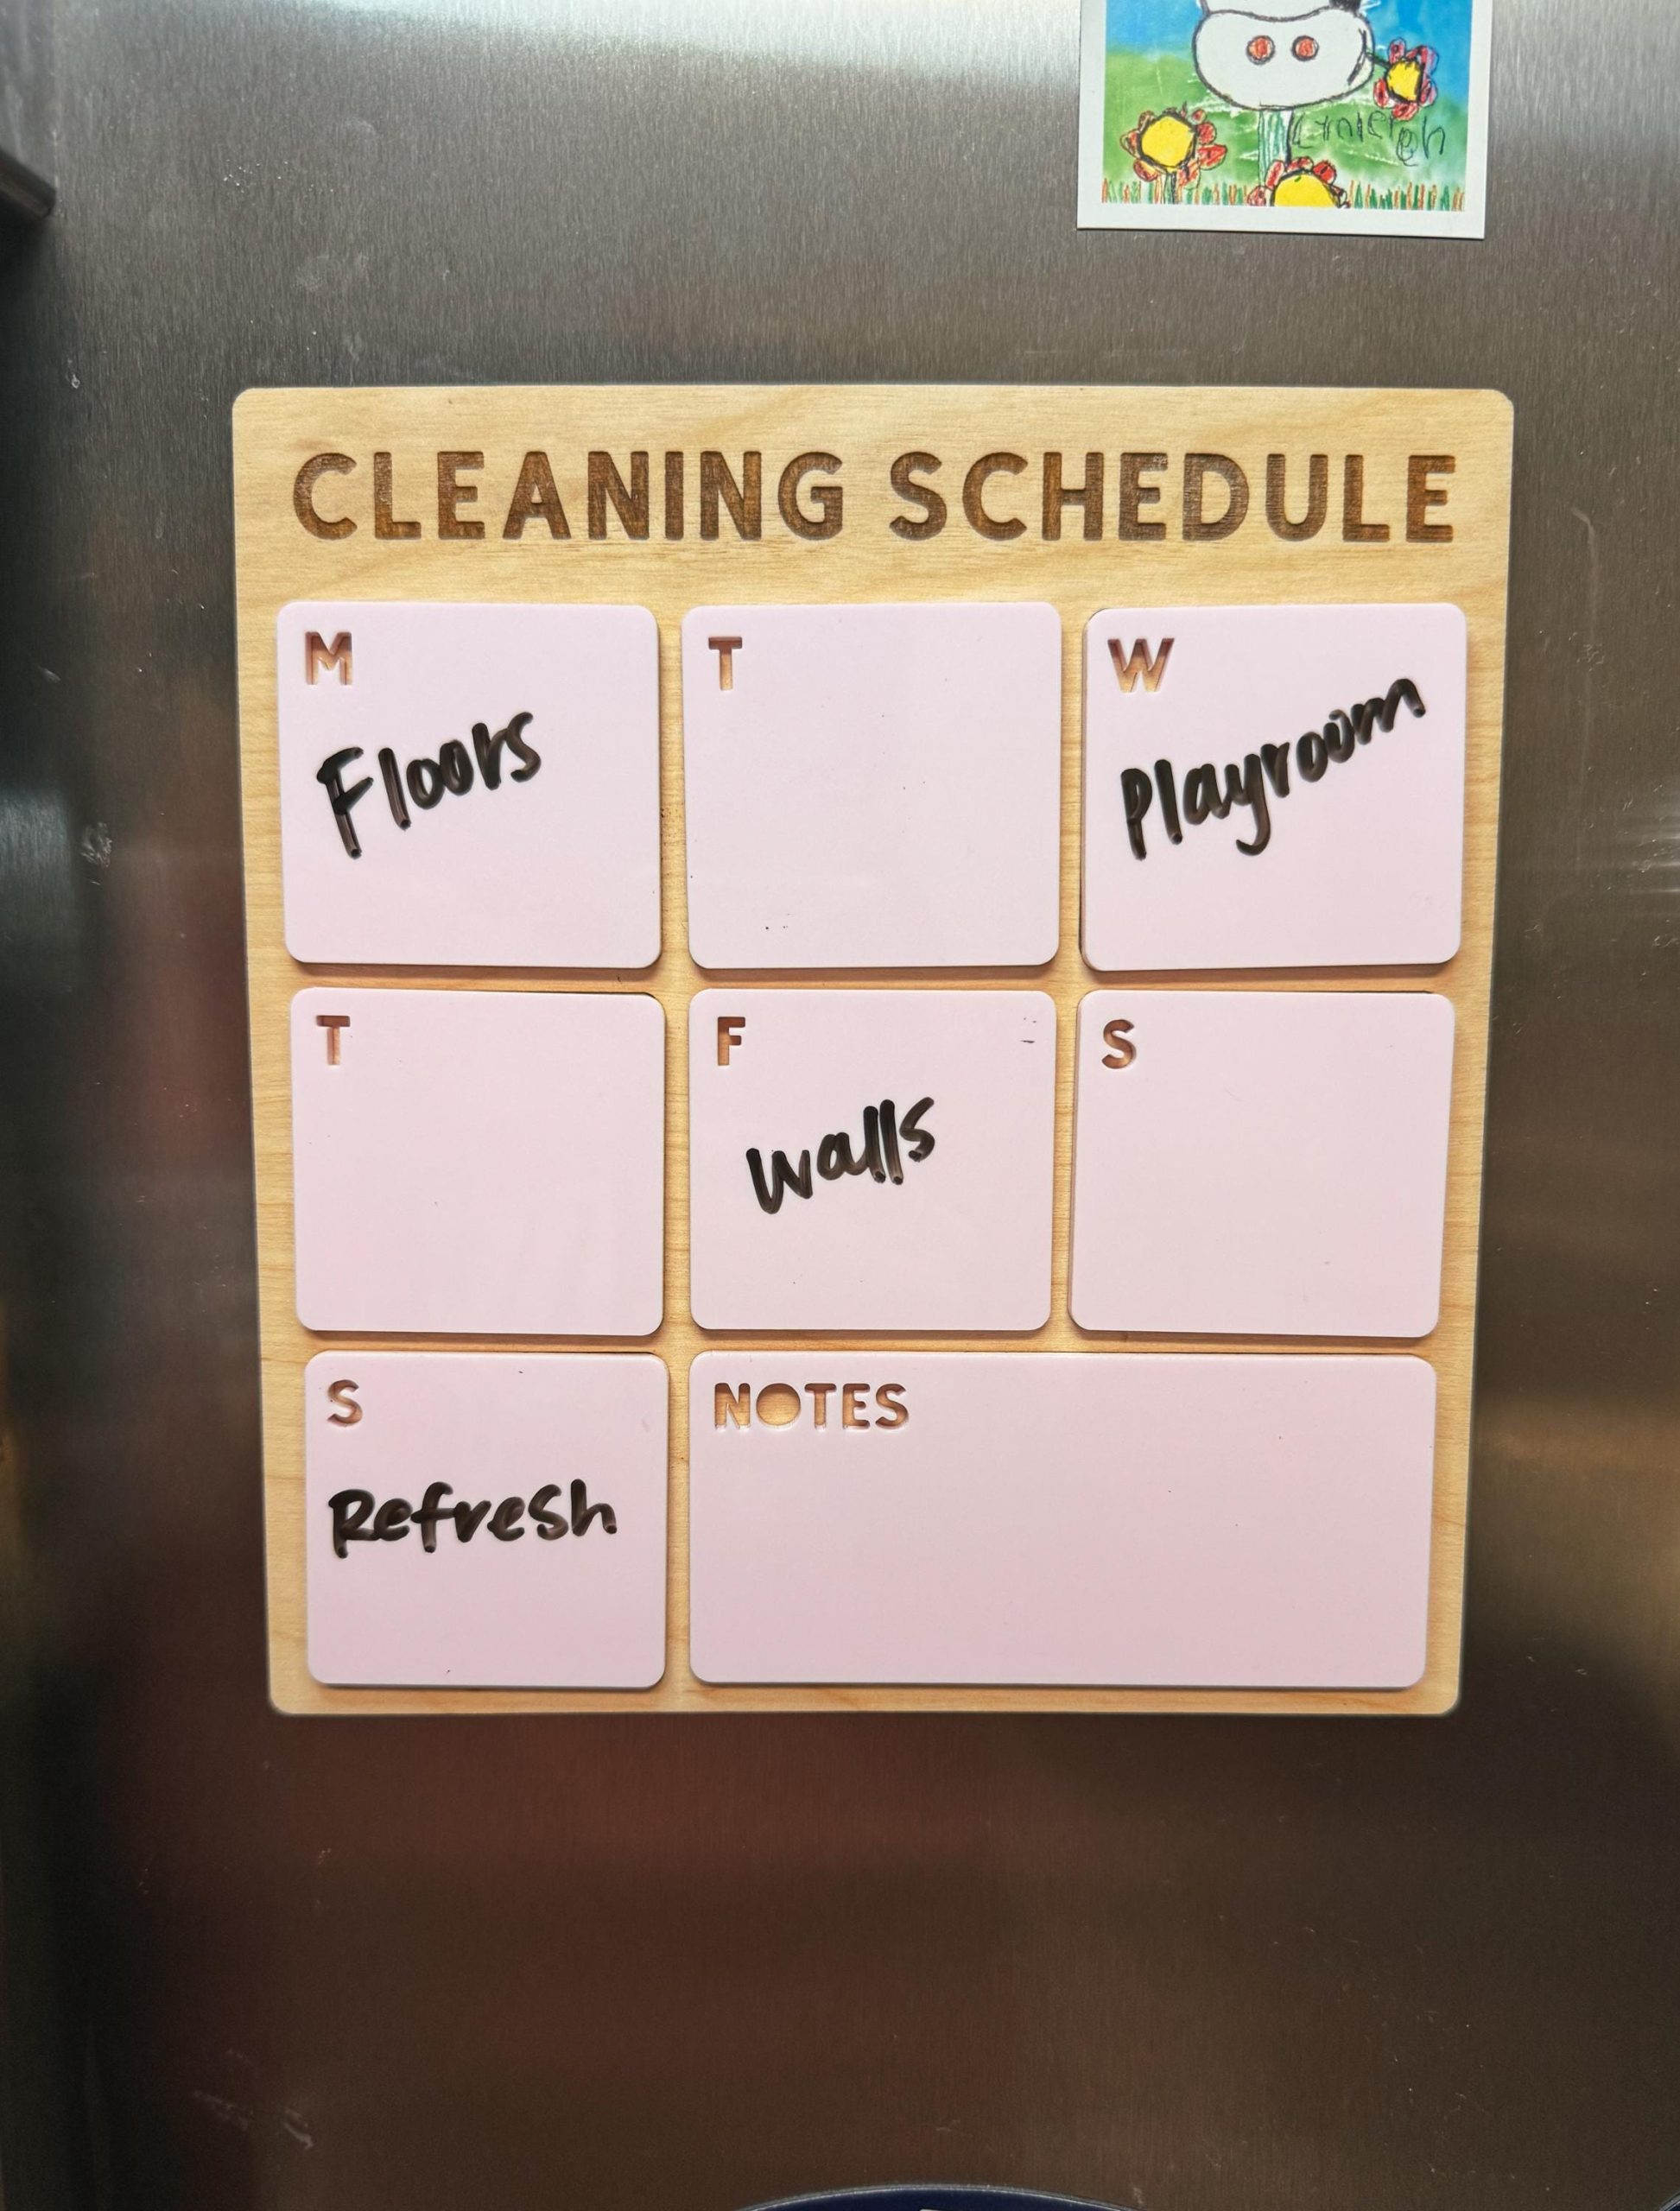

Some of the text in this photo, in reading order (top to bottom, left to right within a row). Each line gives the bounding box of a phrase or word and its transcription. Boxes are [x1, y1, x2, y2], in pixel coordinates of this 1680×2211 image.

[291, 449, 1457, 544] CLEANING SCHEDULE
[303, 630, 354, 687] M
[707, 635, 745, 692] T
[1106, 636, 1176, 694] W
[315, 711, 542, 860] Floors
[314, 1013, 352, 1067] T
[715, 1015, 747, 1067] F
[1100, 1017, 1138, 1071] S
[325, 1378, 365, 1429] S
[713, 1381, 911, 1431] NOTES
[326, 1478, 618, 1560] Refresh
